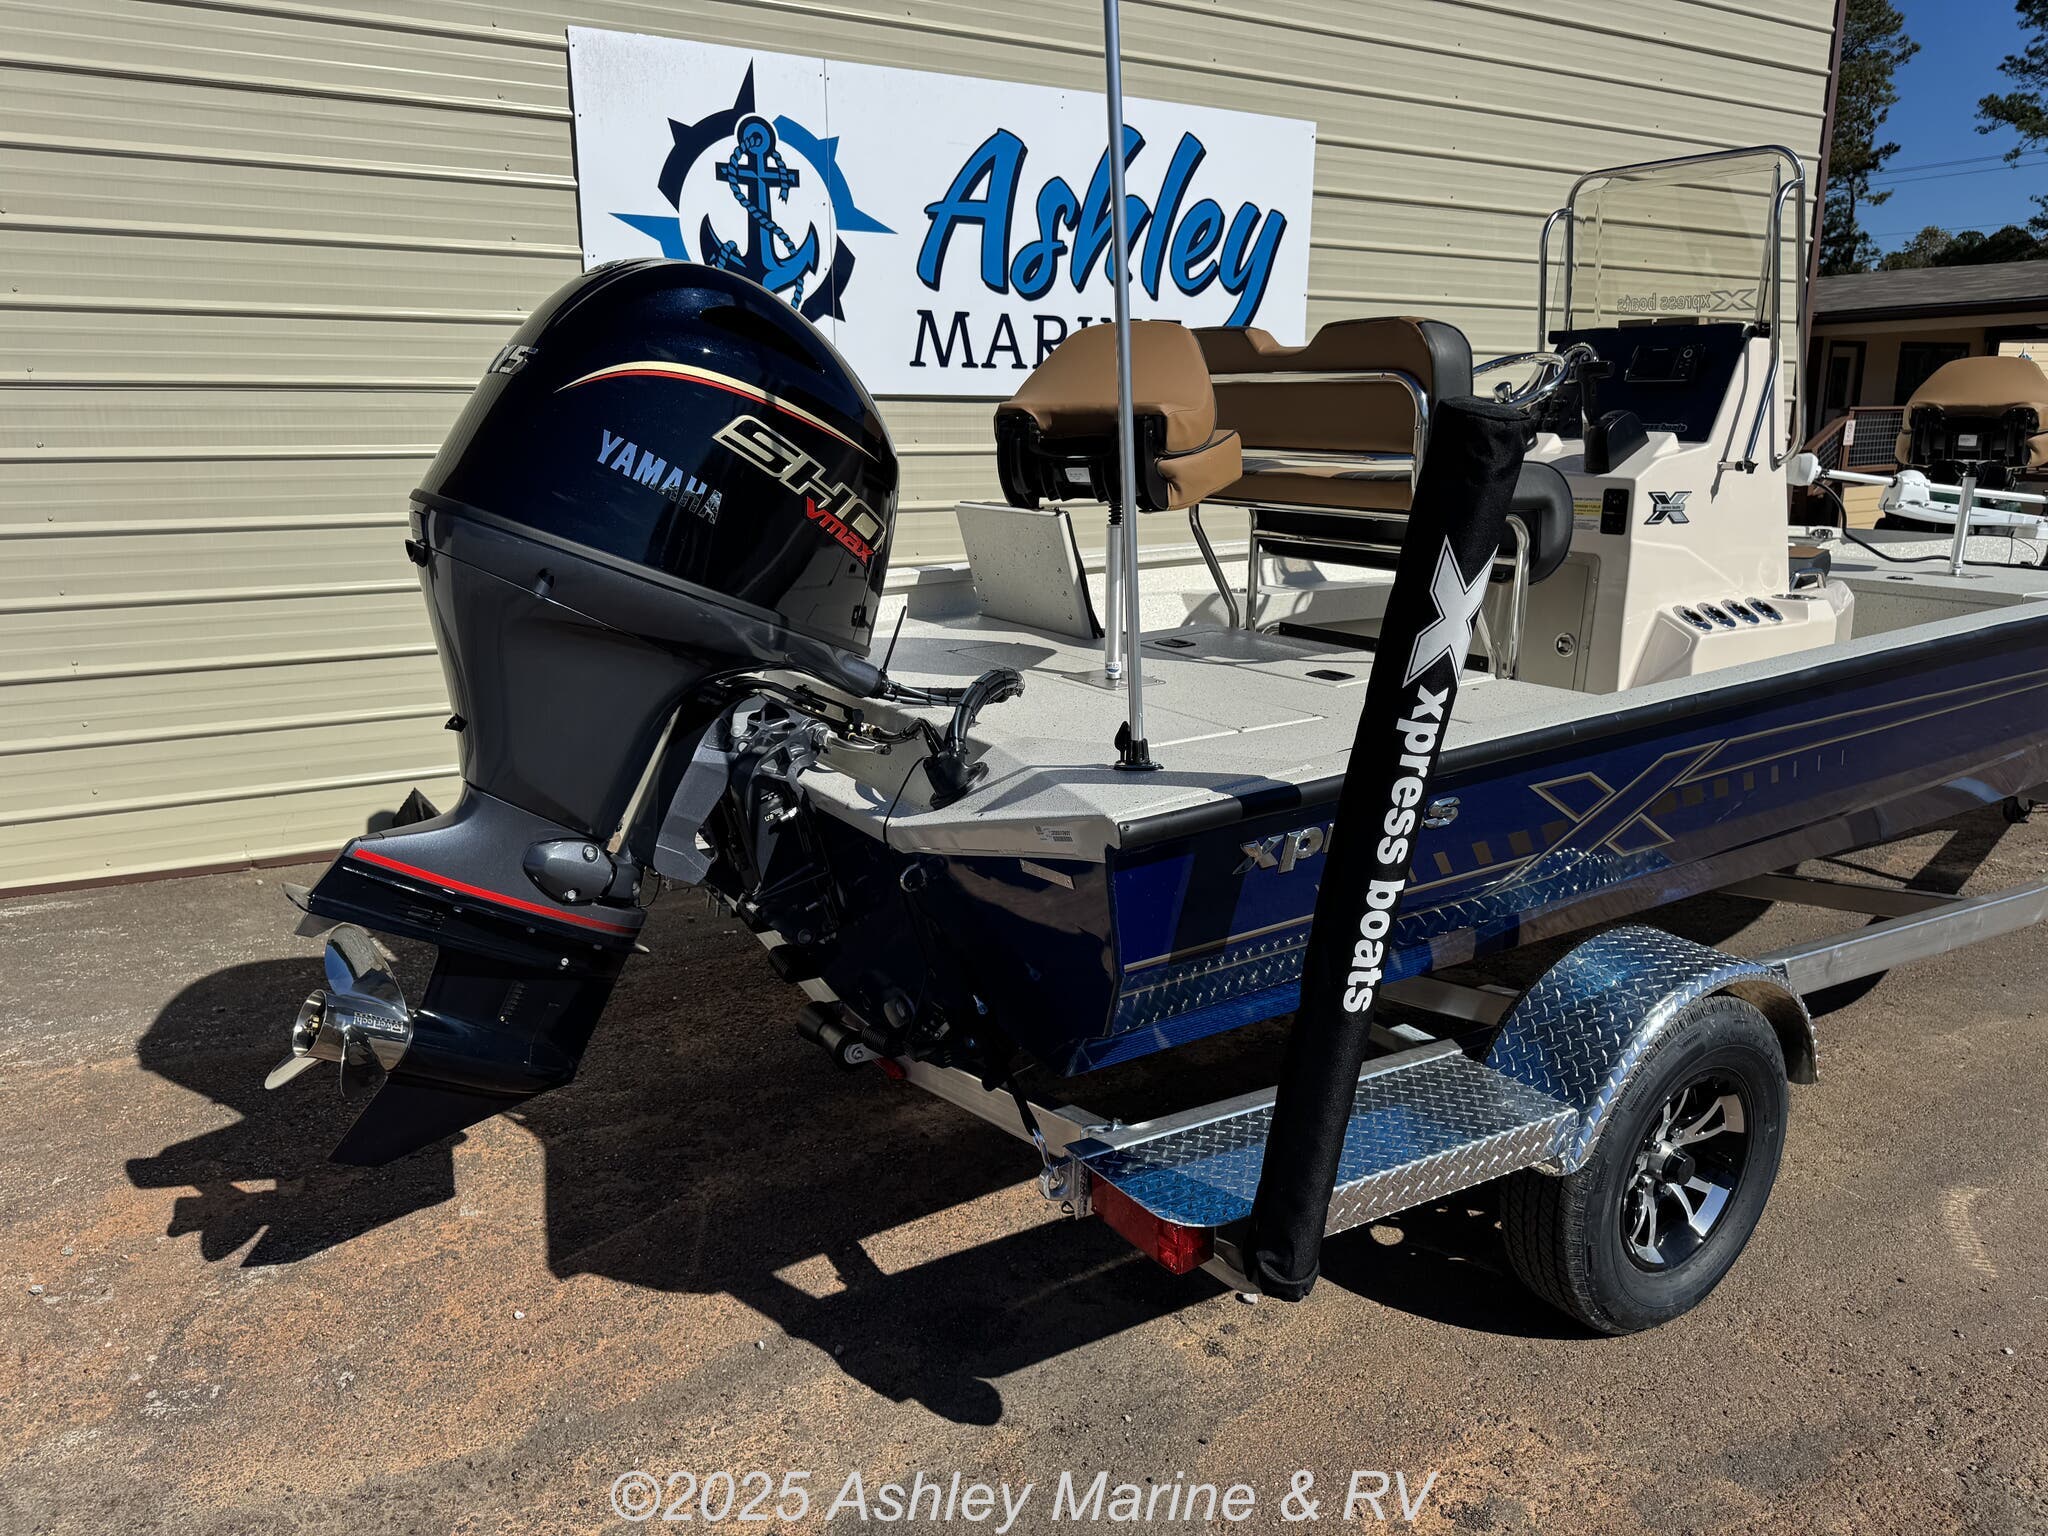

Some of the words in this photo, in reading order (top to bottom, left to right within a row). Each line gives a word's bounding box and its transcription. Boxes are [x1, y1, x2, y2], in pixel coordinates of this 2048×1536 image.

[917, 124, 1287, 328] Ashley
[909, 309, 1181, 369] MAR
[596, 429, 723, 525] YAMAHA
[712, 415, 886, 551] SHO
[1232, 797, 1461, 875] xps
[1377, 685, 1449, 864] xpress
[1343, 880, 1406, 1012] boats
